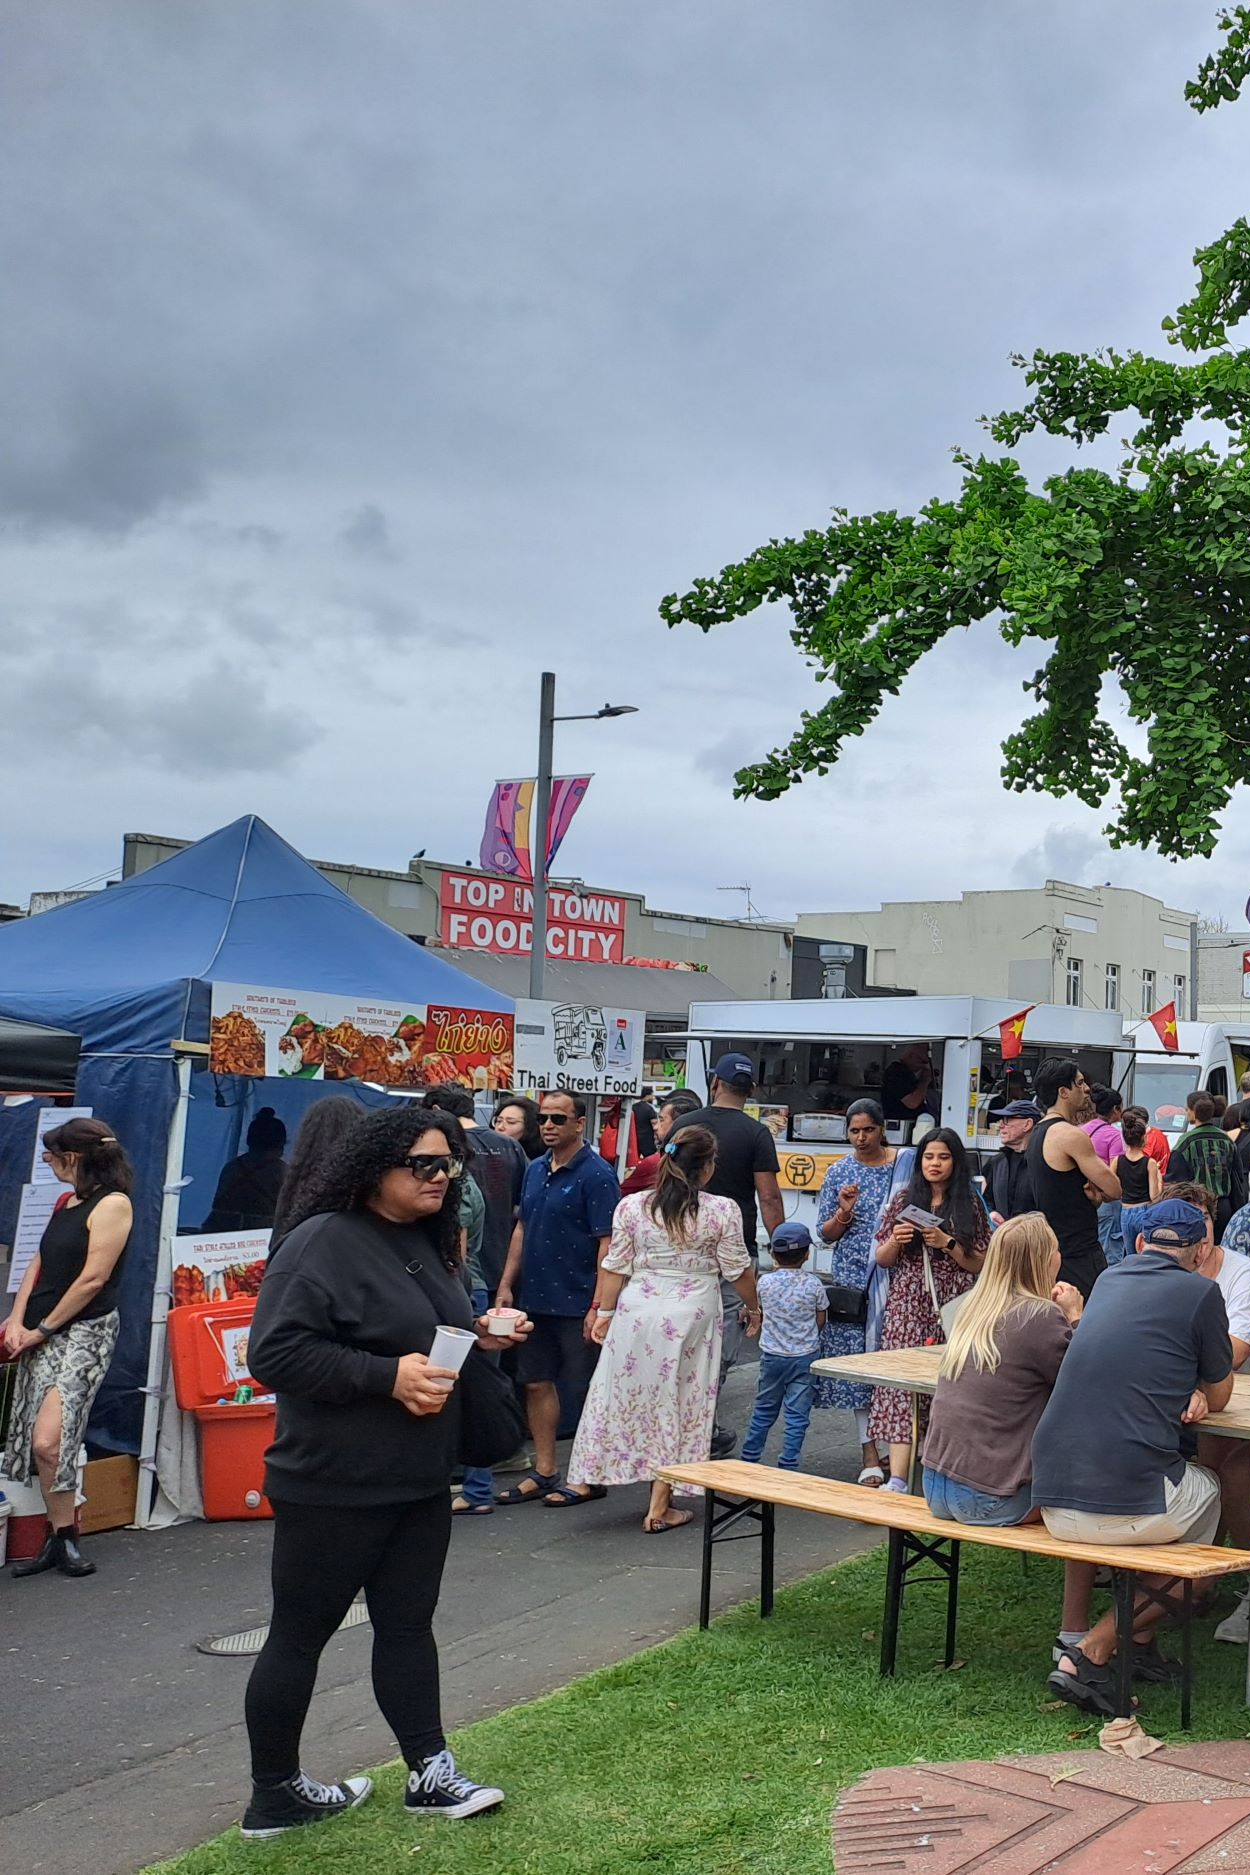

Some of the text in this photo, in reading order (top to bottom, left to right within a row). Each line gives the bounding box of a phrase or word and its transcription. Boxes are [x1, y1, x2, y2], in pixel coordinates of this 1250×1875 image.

[449, 876, 620, 925] TOP IN TOWN
[450, 913, 617, 960] FOOD CITY
[431, 1010, 509, 1055] ไก่ย่าง
[614, 1031, 626, 1050] A
[517, 1070, 638, 1094] Thai Street Food
